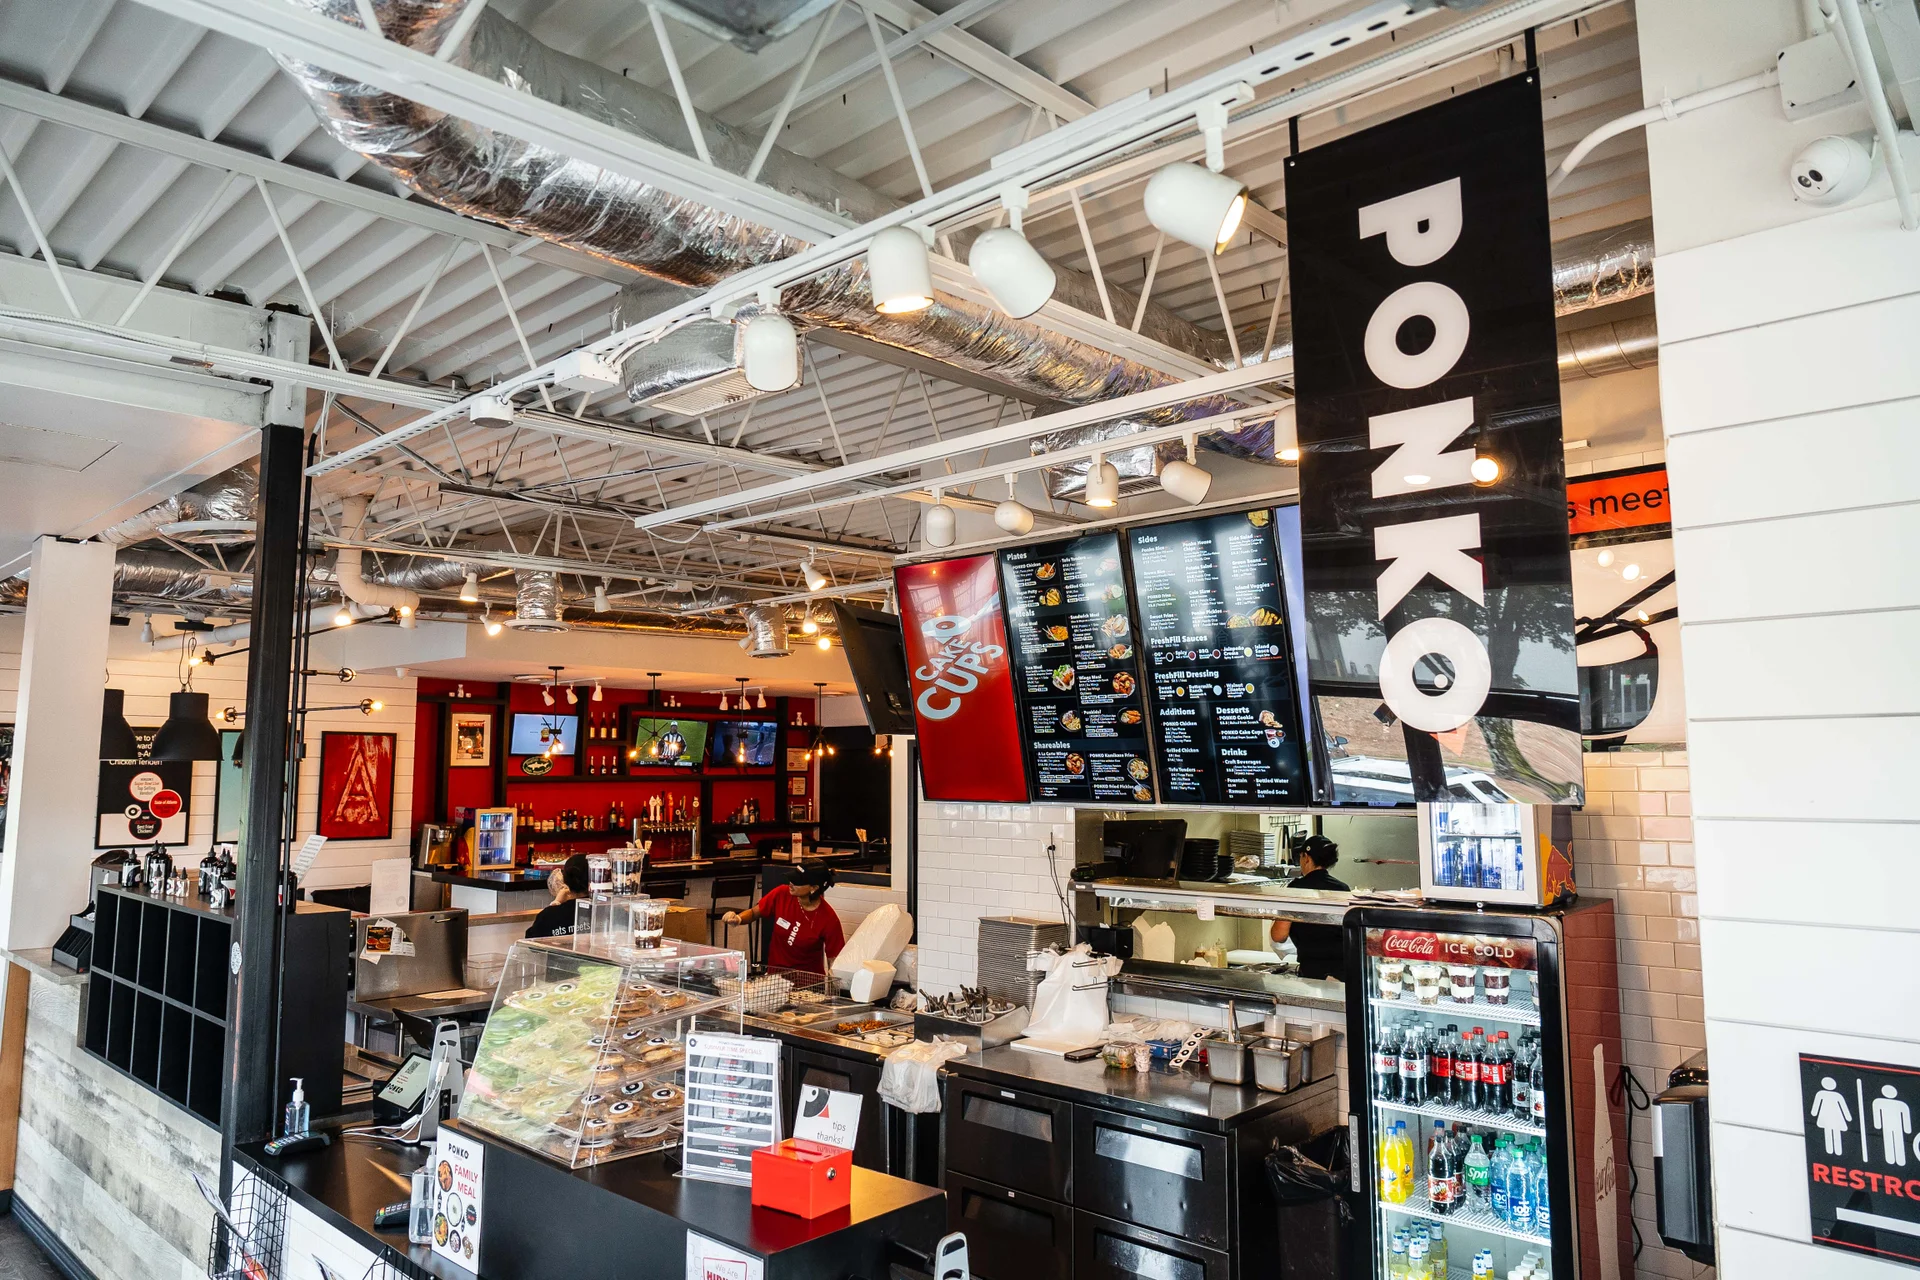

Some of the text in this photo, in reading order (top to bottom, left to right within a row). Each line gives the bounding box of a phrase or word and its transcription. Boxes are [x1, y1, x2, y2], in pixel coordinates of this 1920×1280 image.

[1359, 177, 1491, 732] PONKO
[1138, 536, 1158, 544] Sides
[1006, 553, 1027, 561] Plates
[1015, 609, 1035, 617] Meals
[1151, 635, 1208, 645] FreshFill Sauces
[915, 638, 971, 681] CAKE
[917, 641, 1004, 719] CUPS
[1154, 669, 1219, 680] FreshFill Dressing
[1160, 708, 1195, 716] Additions
[1033, 741, 1070, 749] Shareables
[1221, 748, 1248, 756] Drinks
[1385, 934, 1434, 954] Coca-Cola
[1444, 943, 1514, 958] ICE COLD
[832, 1120, 846, 1132] tips
[817, 1131, 844, 1144] thanks!
[448, 1143, 469, 1159] PONKO
[454, 1164, 478, 1183] FAMILY
[457, 1181, 476, 1199] MEAL
[715, 1262, 726, 1273] We
[727, 1269, 738, 1279] Are
